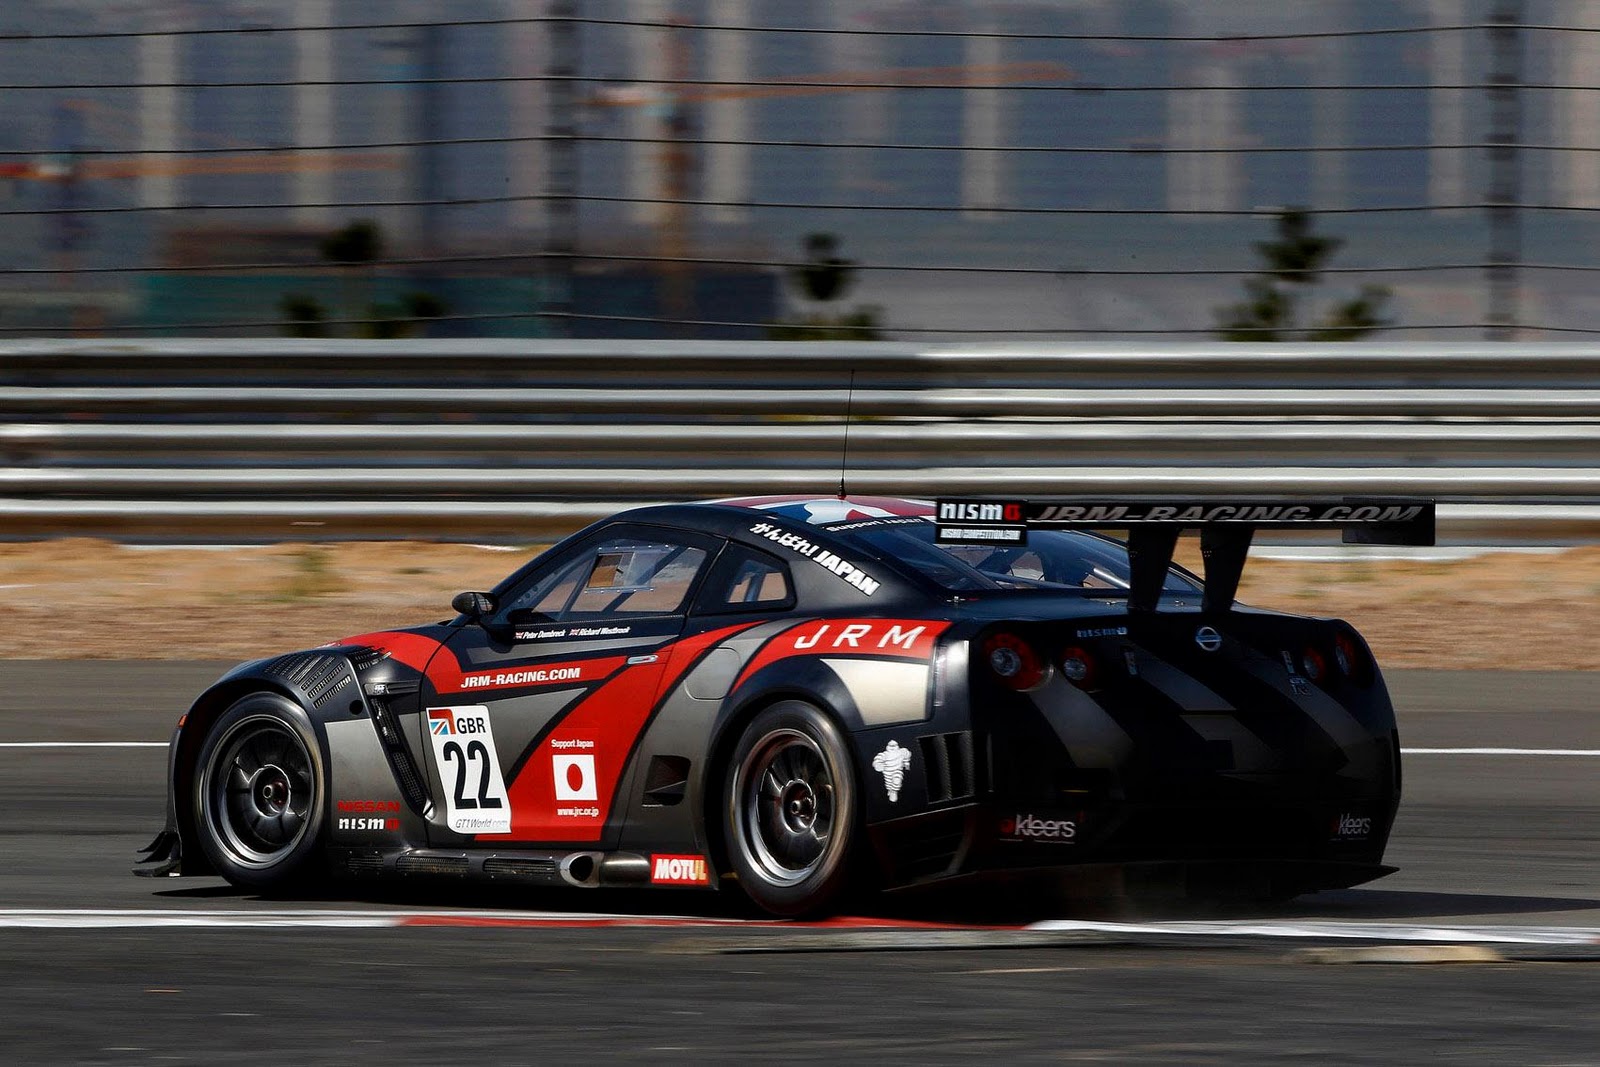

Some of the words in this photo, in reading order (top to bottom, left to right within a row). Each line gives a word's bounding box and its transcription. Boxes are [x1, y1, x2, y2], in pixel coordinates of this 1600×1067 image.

[825, 520, 883, 532] Support
[812, 550, 881, 597] JAPAN
[522, 631, 539, 640] Peter
[579, 627, 602, 637] Richard
[460, 667, 581, 689] JRM-RACING.COM
[456, 717, 487, 734] GBR
[551, 738, 576, 750] Support
[576, 739, 595, 749] Japan
[443, 739, 503, 810] 22
[337, 800, 401, 813] NISSAN
[1014, 813, 1077, 838] kleers
[653, 858, 707, 881] MOTUL
